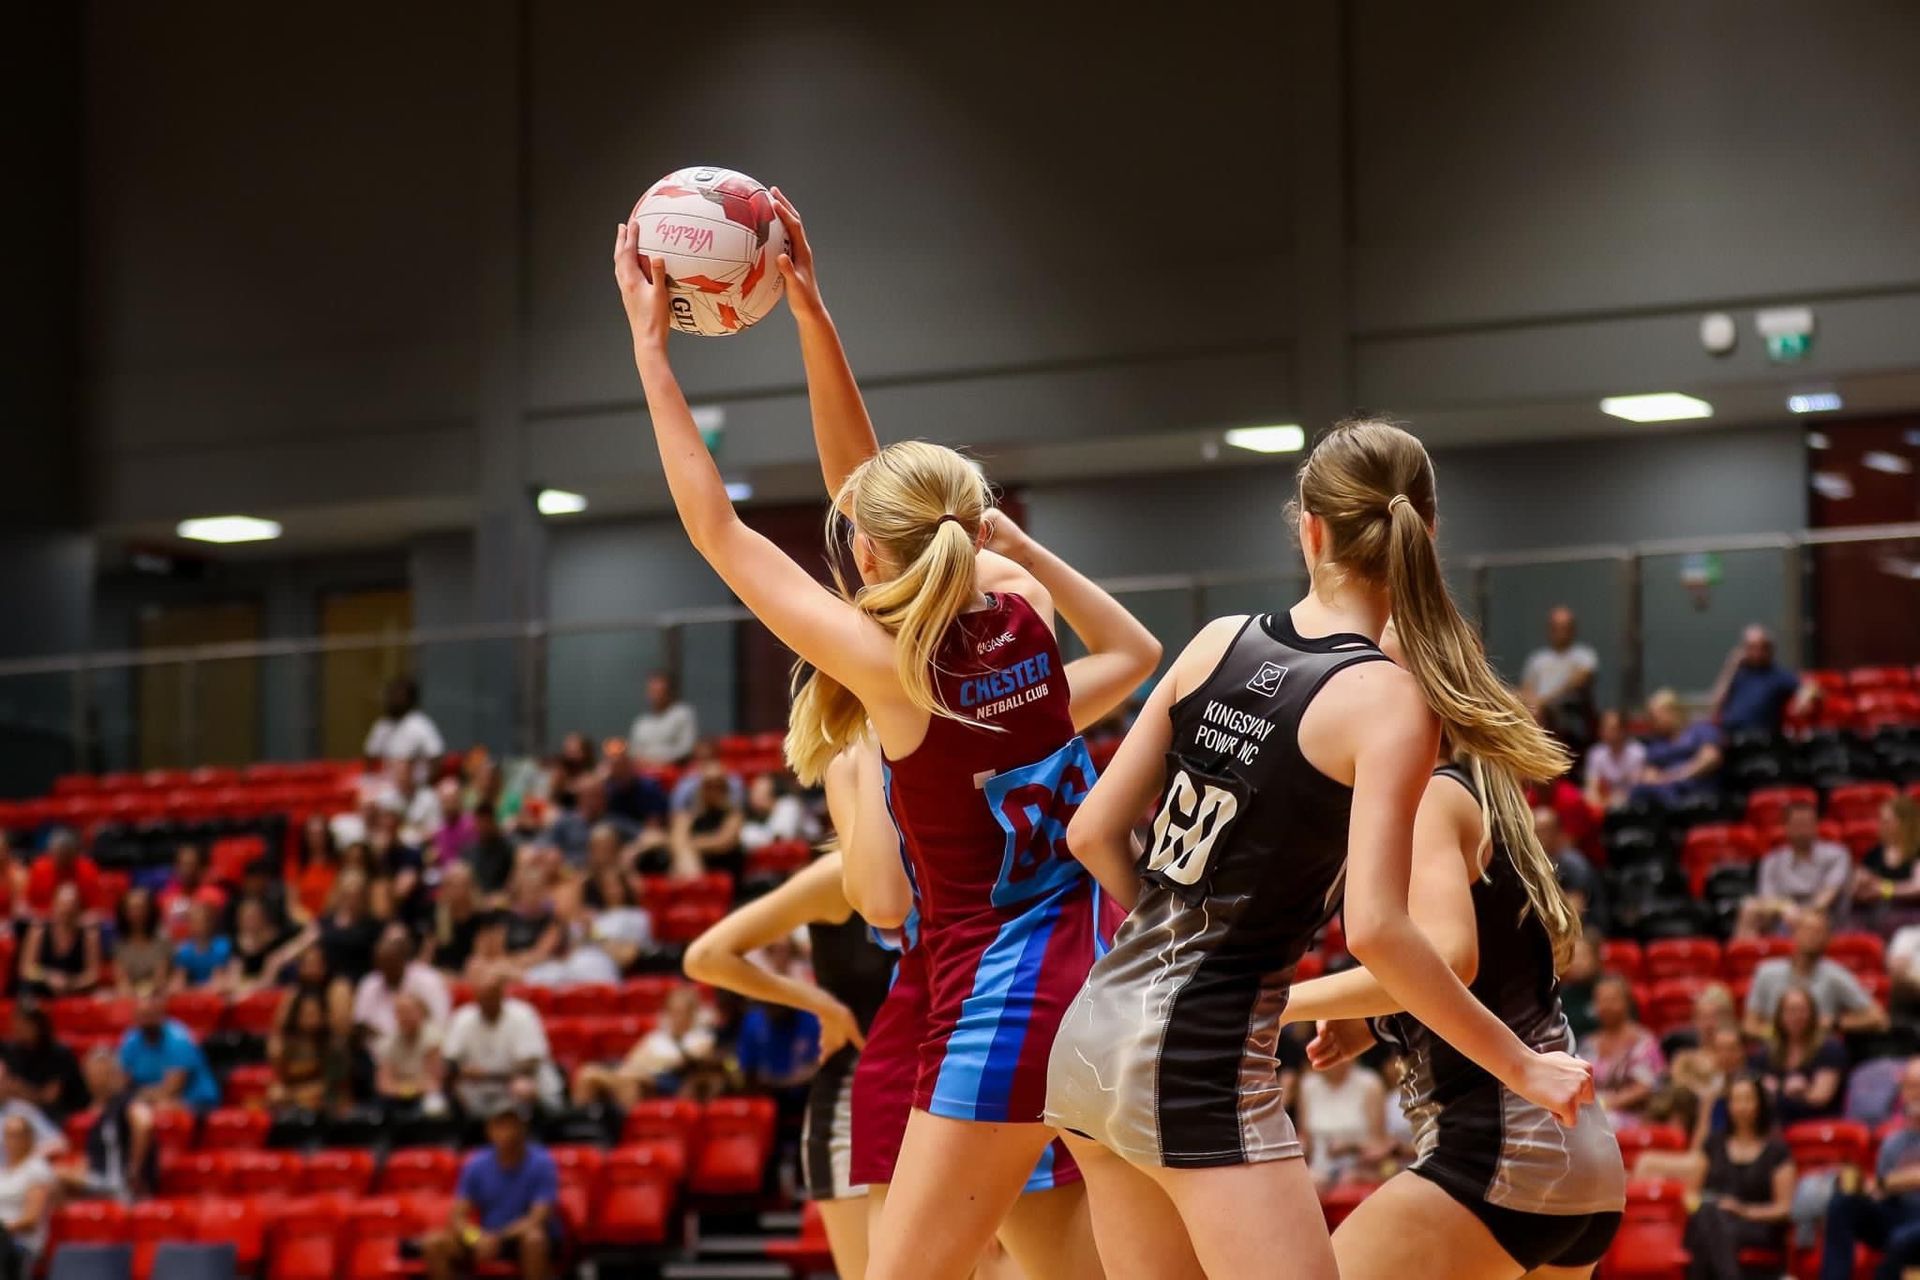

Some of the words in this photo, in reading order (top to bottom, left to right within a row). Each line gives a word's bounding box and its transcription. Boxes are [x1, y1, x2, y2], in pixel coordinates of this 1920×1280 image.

[656, 216, 713, 253] Vitality
[960, 652, 1051, 707] CHESTER
[976, 694, 1025, 720] NETBALL
[1025, 683, 1049, 703] CLUB
[1237, 740, 1259, 766] NC
[1147, 770, 1238, 886] GD
